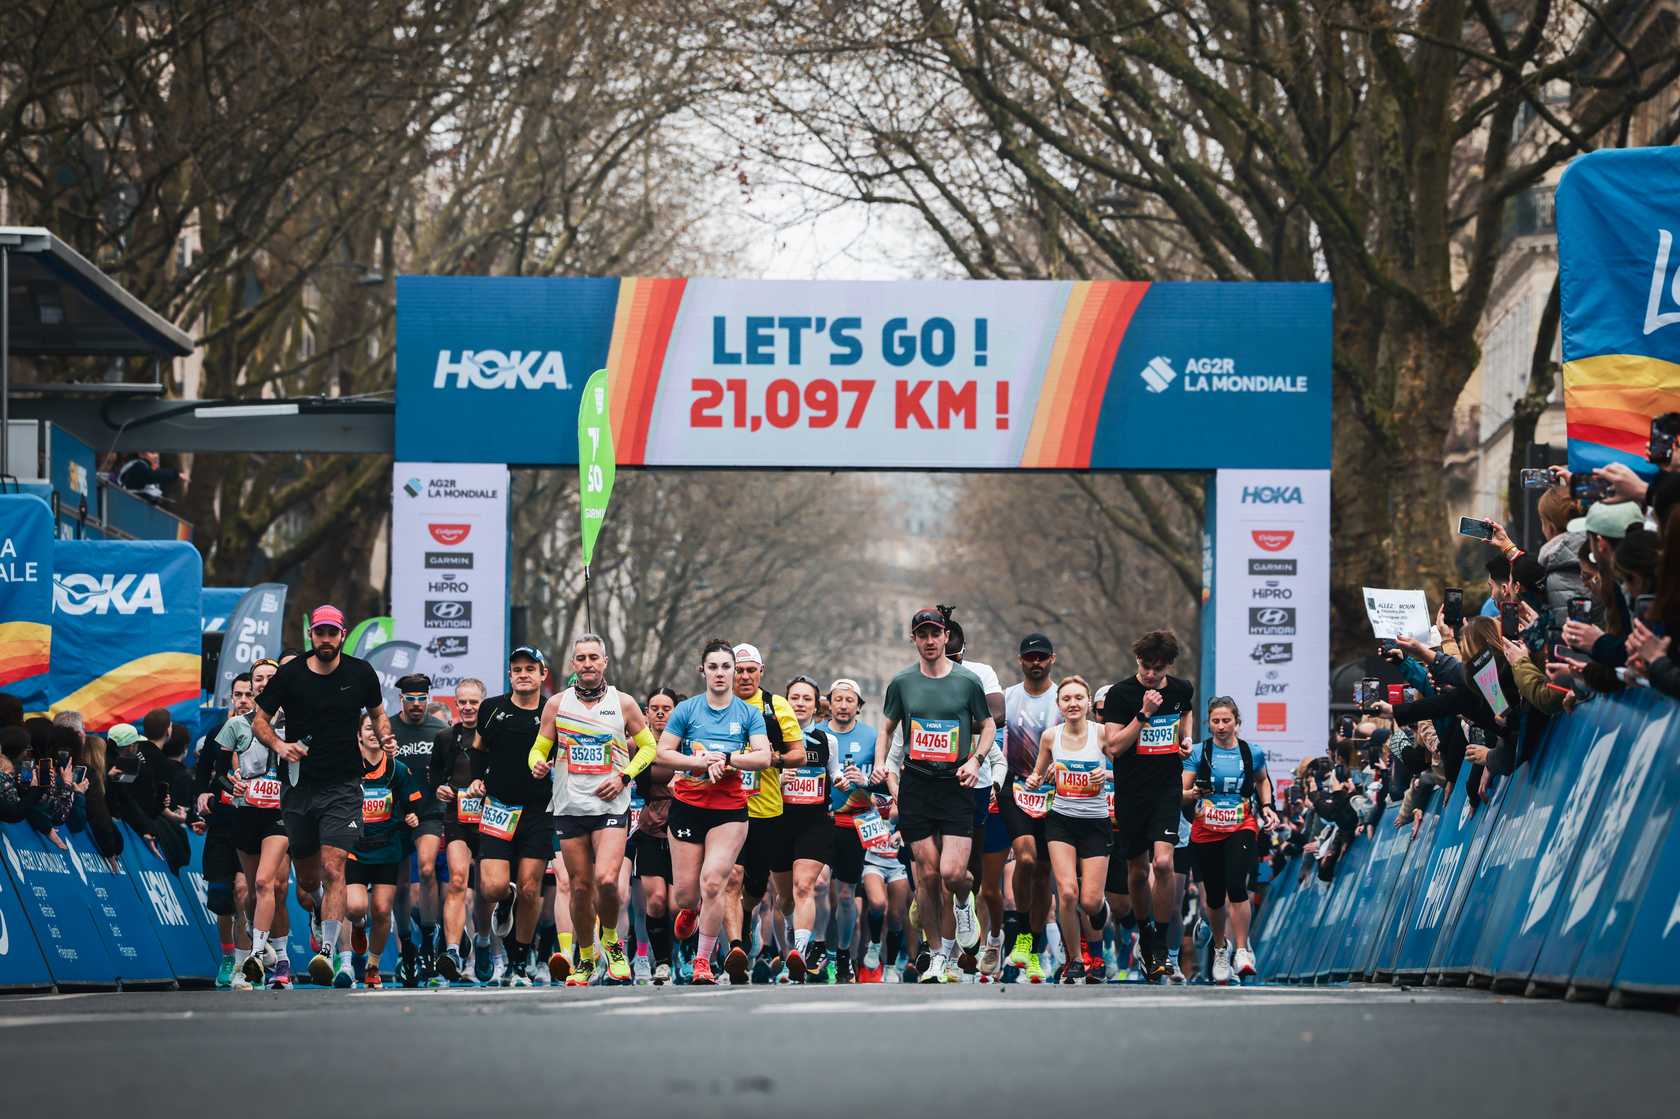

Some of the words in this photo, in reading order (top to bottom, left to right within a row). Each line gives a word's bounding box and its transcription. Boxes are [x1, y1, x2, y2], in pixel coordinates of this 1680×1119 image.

[1643, 229, 1680, 335] L
[713, 316, 862, 365] LET'S
[882, 316, 956, 368] GO
[974, 317, 988, 368] !
[433, 349, 568, 391] HOKA
[1184, 358, 1235, 374] AG2R
[1184, 376, 1210, 391] LA
[1214, 376, 1307, 392] MONDIALE
[690, 378, 876, 433] 21,097
[894, 379, 977, 430] KM
[995, 379, 1009, 430] !
[428, 479, 456, 488] AG2R
[428, 490, 441, 498] LA
[444, 490, 498, 499] MONDIALE
[1241, 486, 1303, 504] HOKA
[430, 556, 470, 565] GARMIN
[1253, 563, 1293, 571] GARMIN
[426, 620, 470, 628] HYUNDAI
[1255, 680, 1288, 697] Lenor
[915, 731, 948, 748] 44765
[1141, 728, 1172, 743] 33993
[571, 746, 603, 761] 35283
[1063, 772, 1089, 787] 14138
[1017, 794, 1045, 806] 43077
